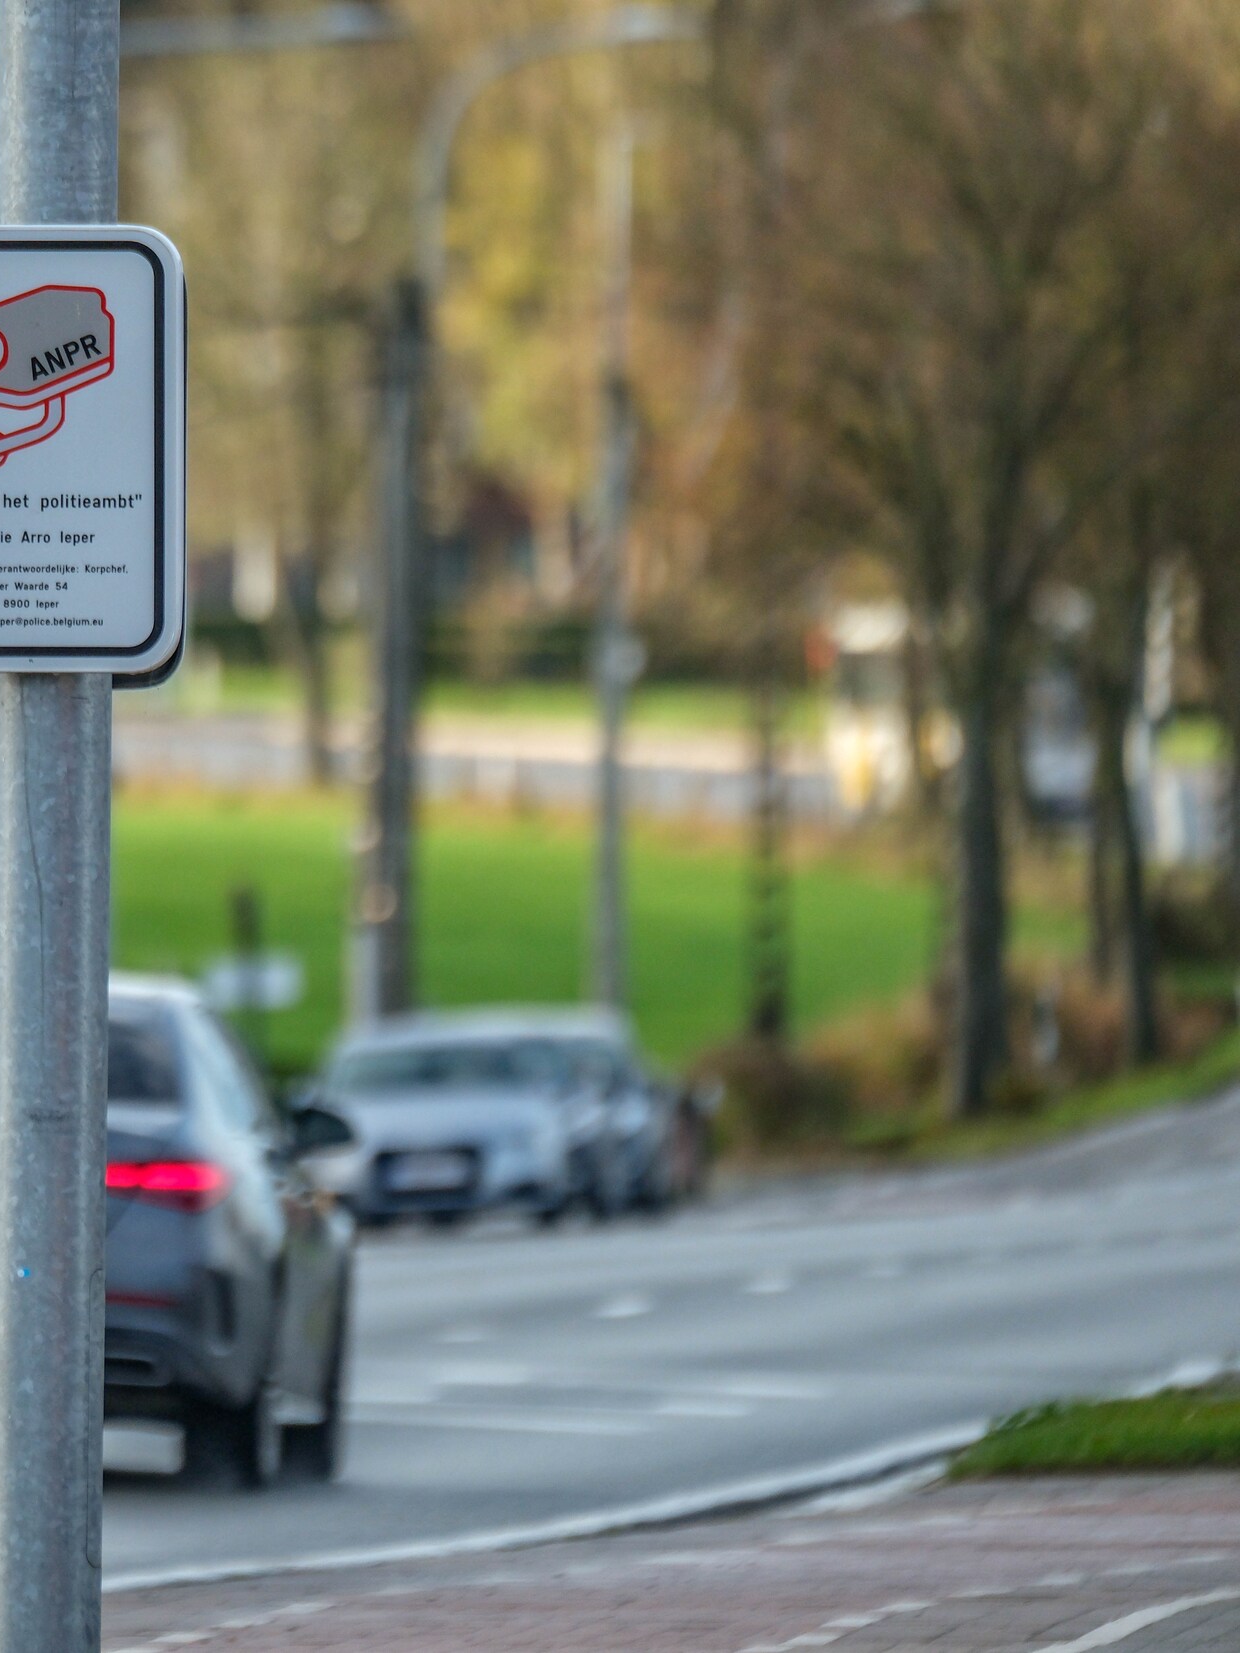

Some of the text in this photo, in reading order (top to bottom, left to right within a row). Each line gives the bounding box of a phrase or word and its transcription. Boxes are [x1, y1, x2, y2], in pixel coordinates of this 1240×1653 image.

[30, 334, 102, 381] ANPR
[3, 493, 29, 508] het
[40, 493, 143, 512] politieambt"
[21, 531, 51, 544] Arro
[60, 531, 96, 546] Ieper
[14, 582, 50, 591] Waarde
[55, 582, 68, 591] 54
[3, 599, 60, 610] 8900 Ieper
